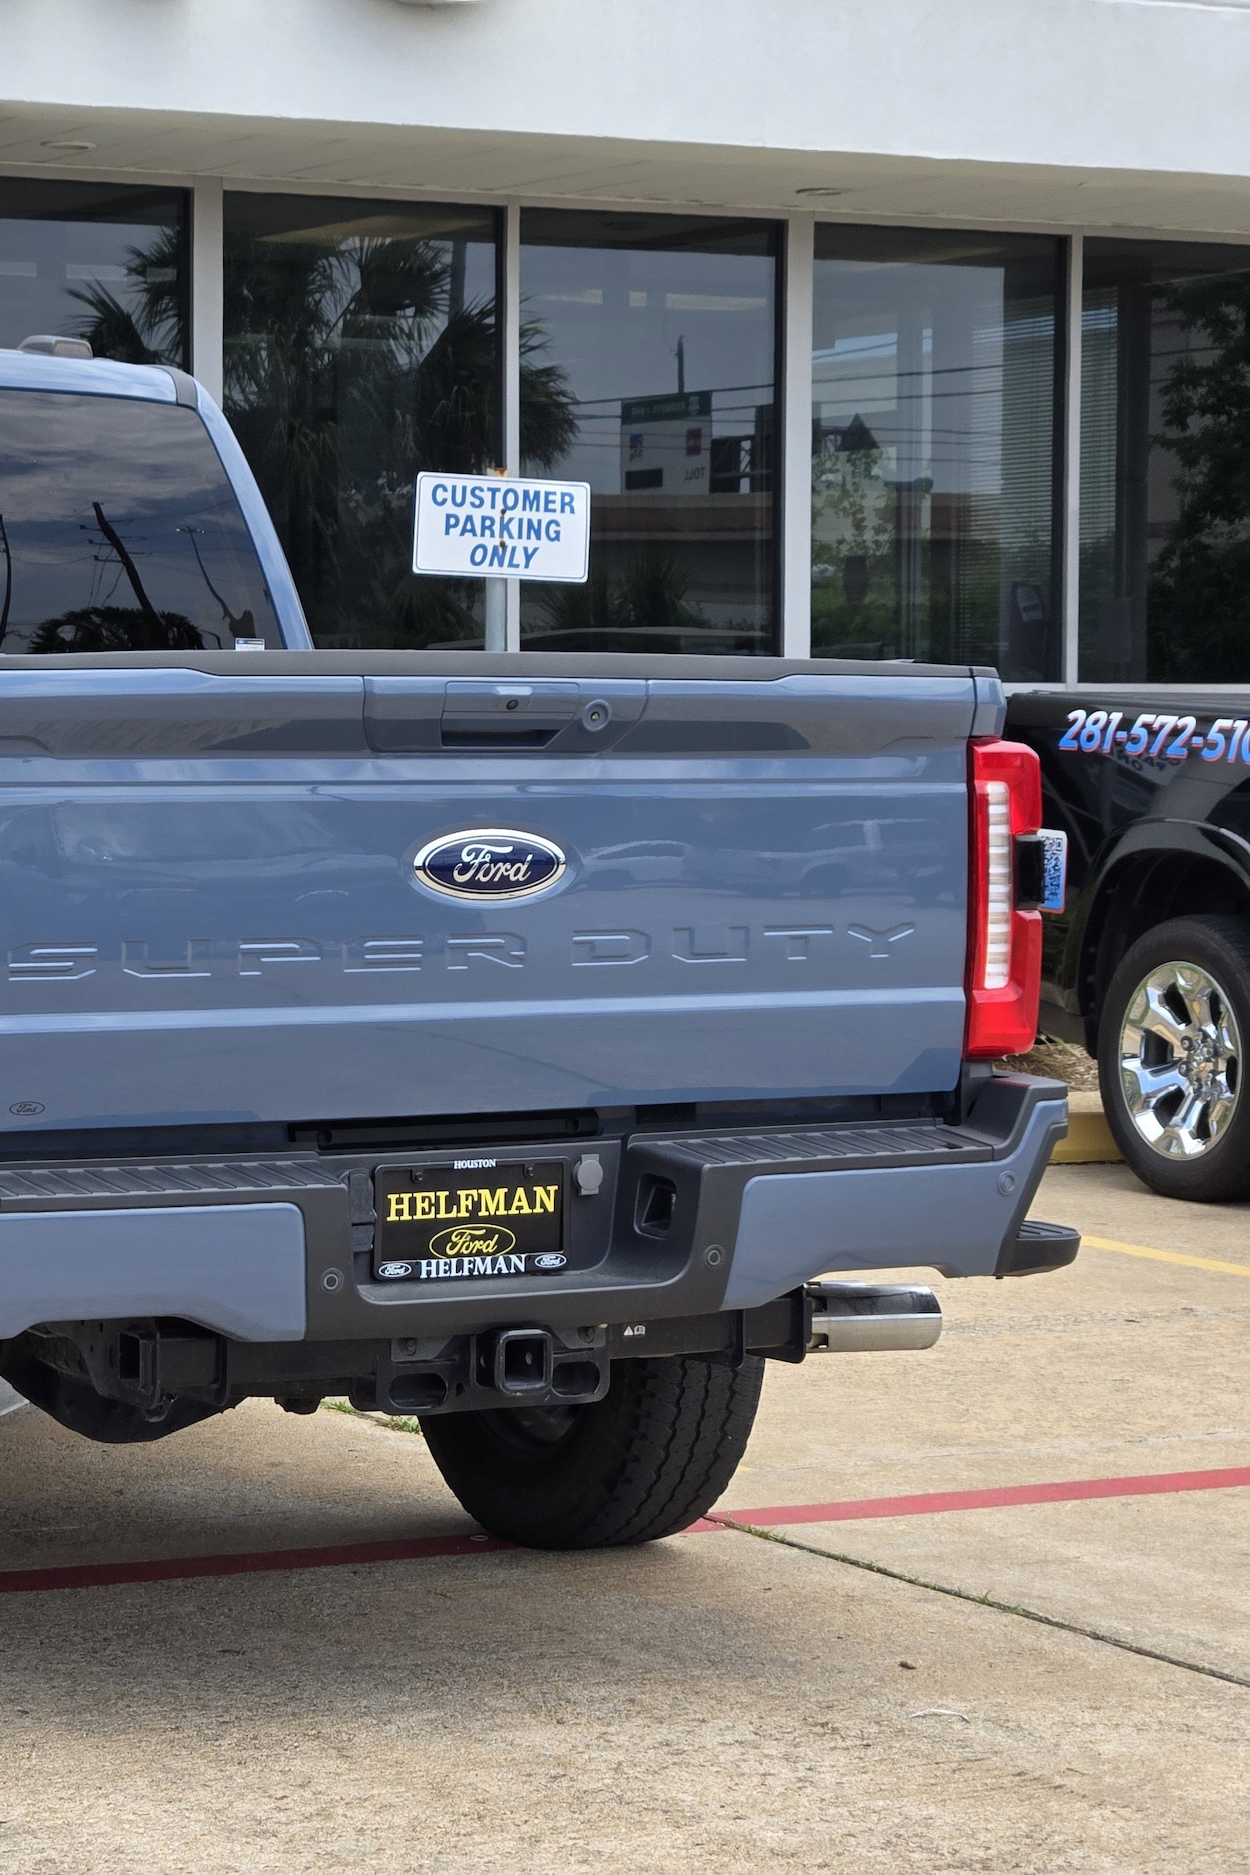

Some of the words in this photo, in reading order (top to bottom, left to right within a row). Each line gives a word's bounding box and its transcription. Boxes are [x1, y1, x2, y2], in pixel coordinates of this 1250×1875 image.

[431, 483, 576, 515] CUSTOMER
[444, 513, 562, 542] PARKING
[469, 543, 540, 570] ONLY
[452, 843, 533, 883] Ford
[7, 931, 527, 981] SUPER
[572, 922, 915, 967] DUTY
[453, 1158, 496, 1170] HOUSTON
[386, 1185, 559, 1222] HELFMAN
[445, 1228, 500, 1256] Ford
[419, 1253, 527, 1279] HELFMAN
